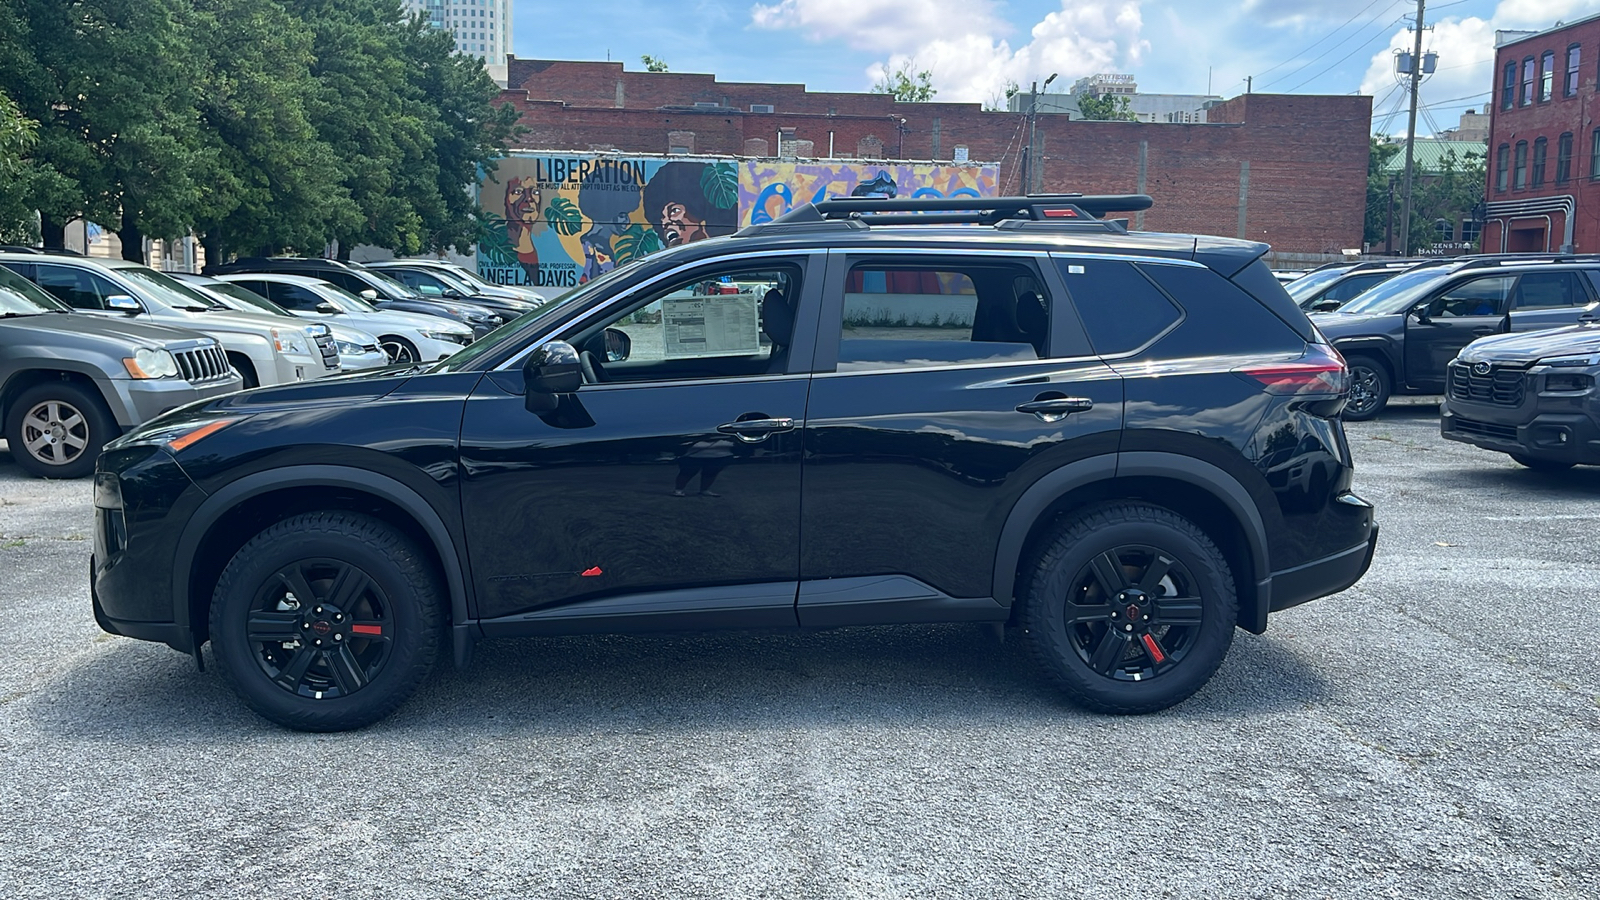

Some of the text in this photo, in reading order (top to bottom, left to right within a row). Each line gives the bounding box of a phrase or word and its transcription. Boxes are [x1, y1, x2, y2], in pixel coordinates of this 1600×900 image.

[537, 158, 645, 185] LIBERATION
[479, 268, 576, 287] ANGELA DAVIS
